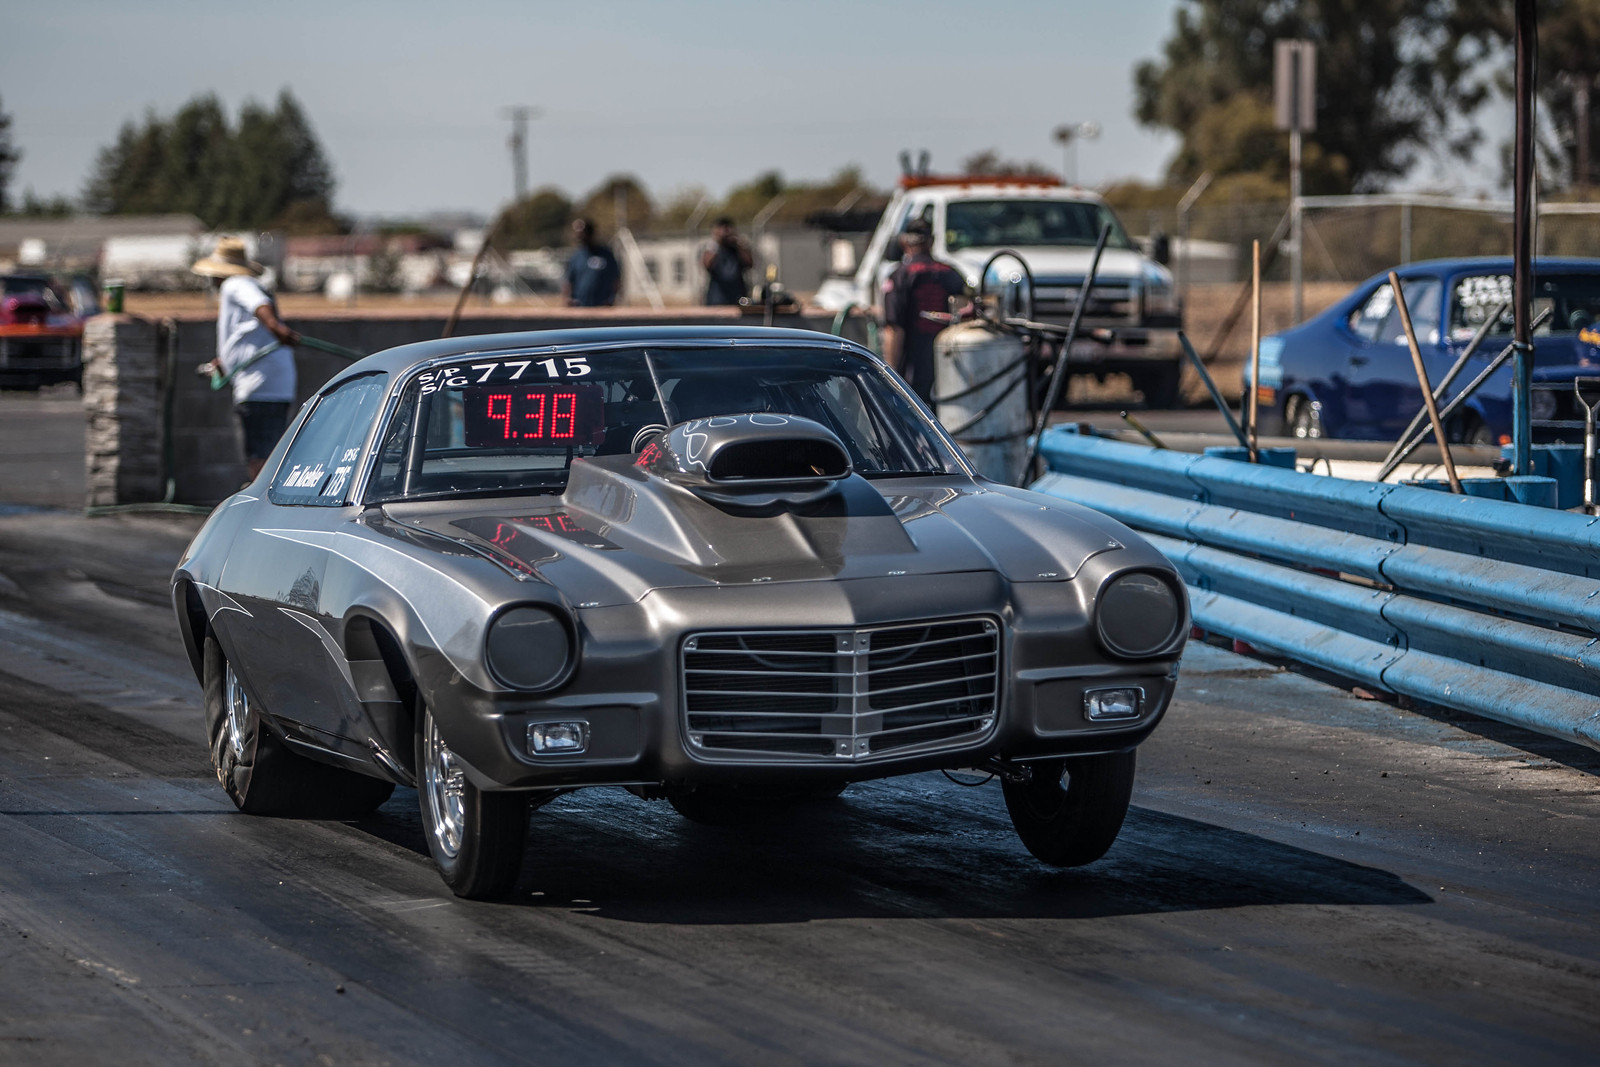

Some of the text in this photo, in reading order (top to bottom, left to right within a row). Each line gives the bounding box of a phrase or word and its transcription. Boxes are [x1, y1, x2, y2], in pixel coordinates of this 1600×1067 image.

[418, 367, 460, 385] S/P
[471, 357, 592, 383] 7715
[421, 376, 468, 395] S/G
[487, 393, 577, 439] 9.38
